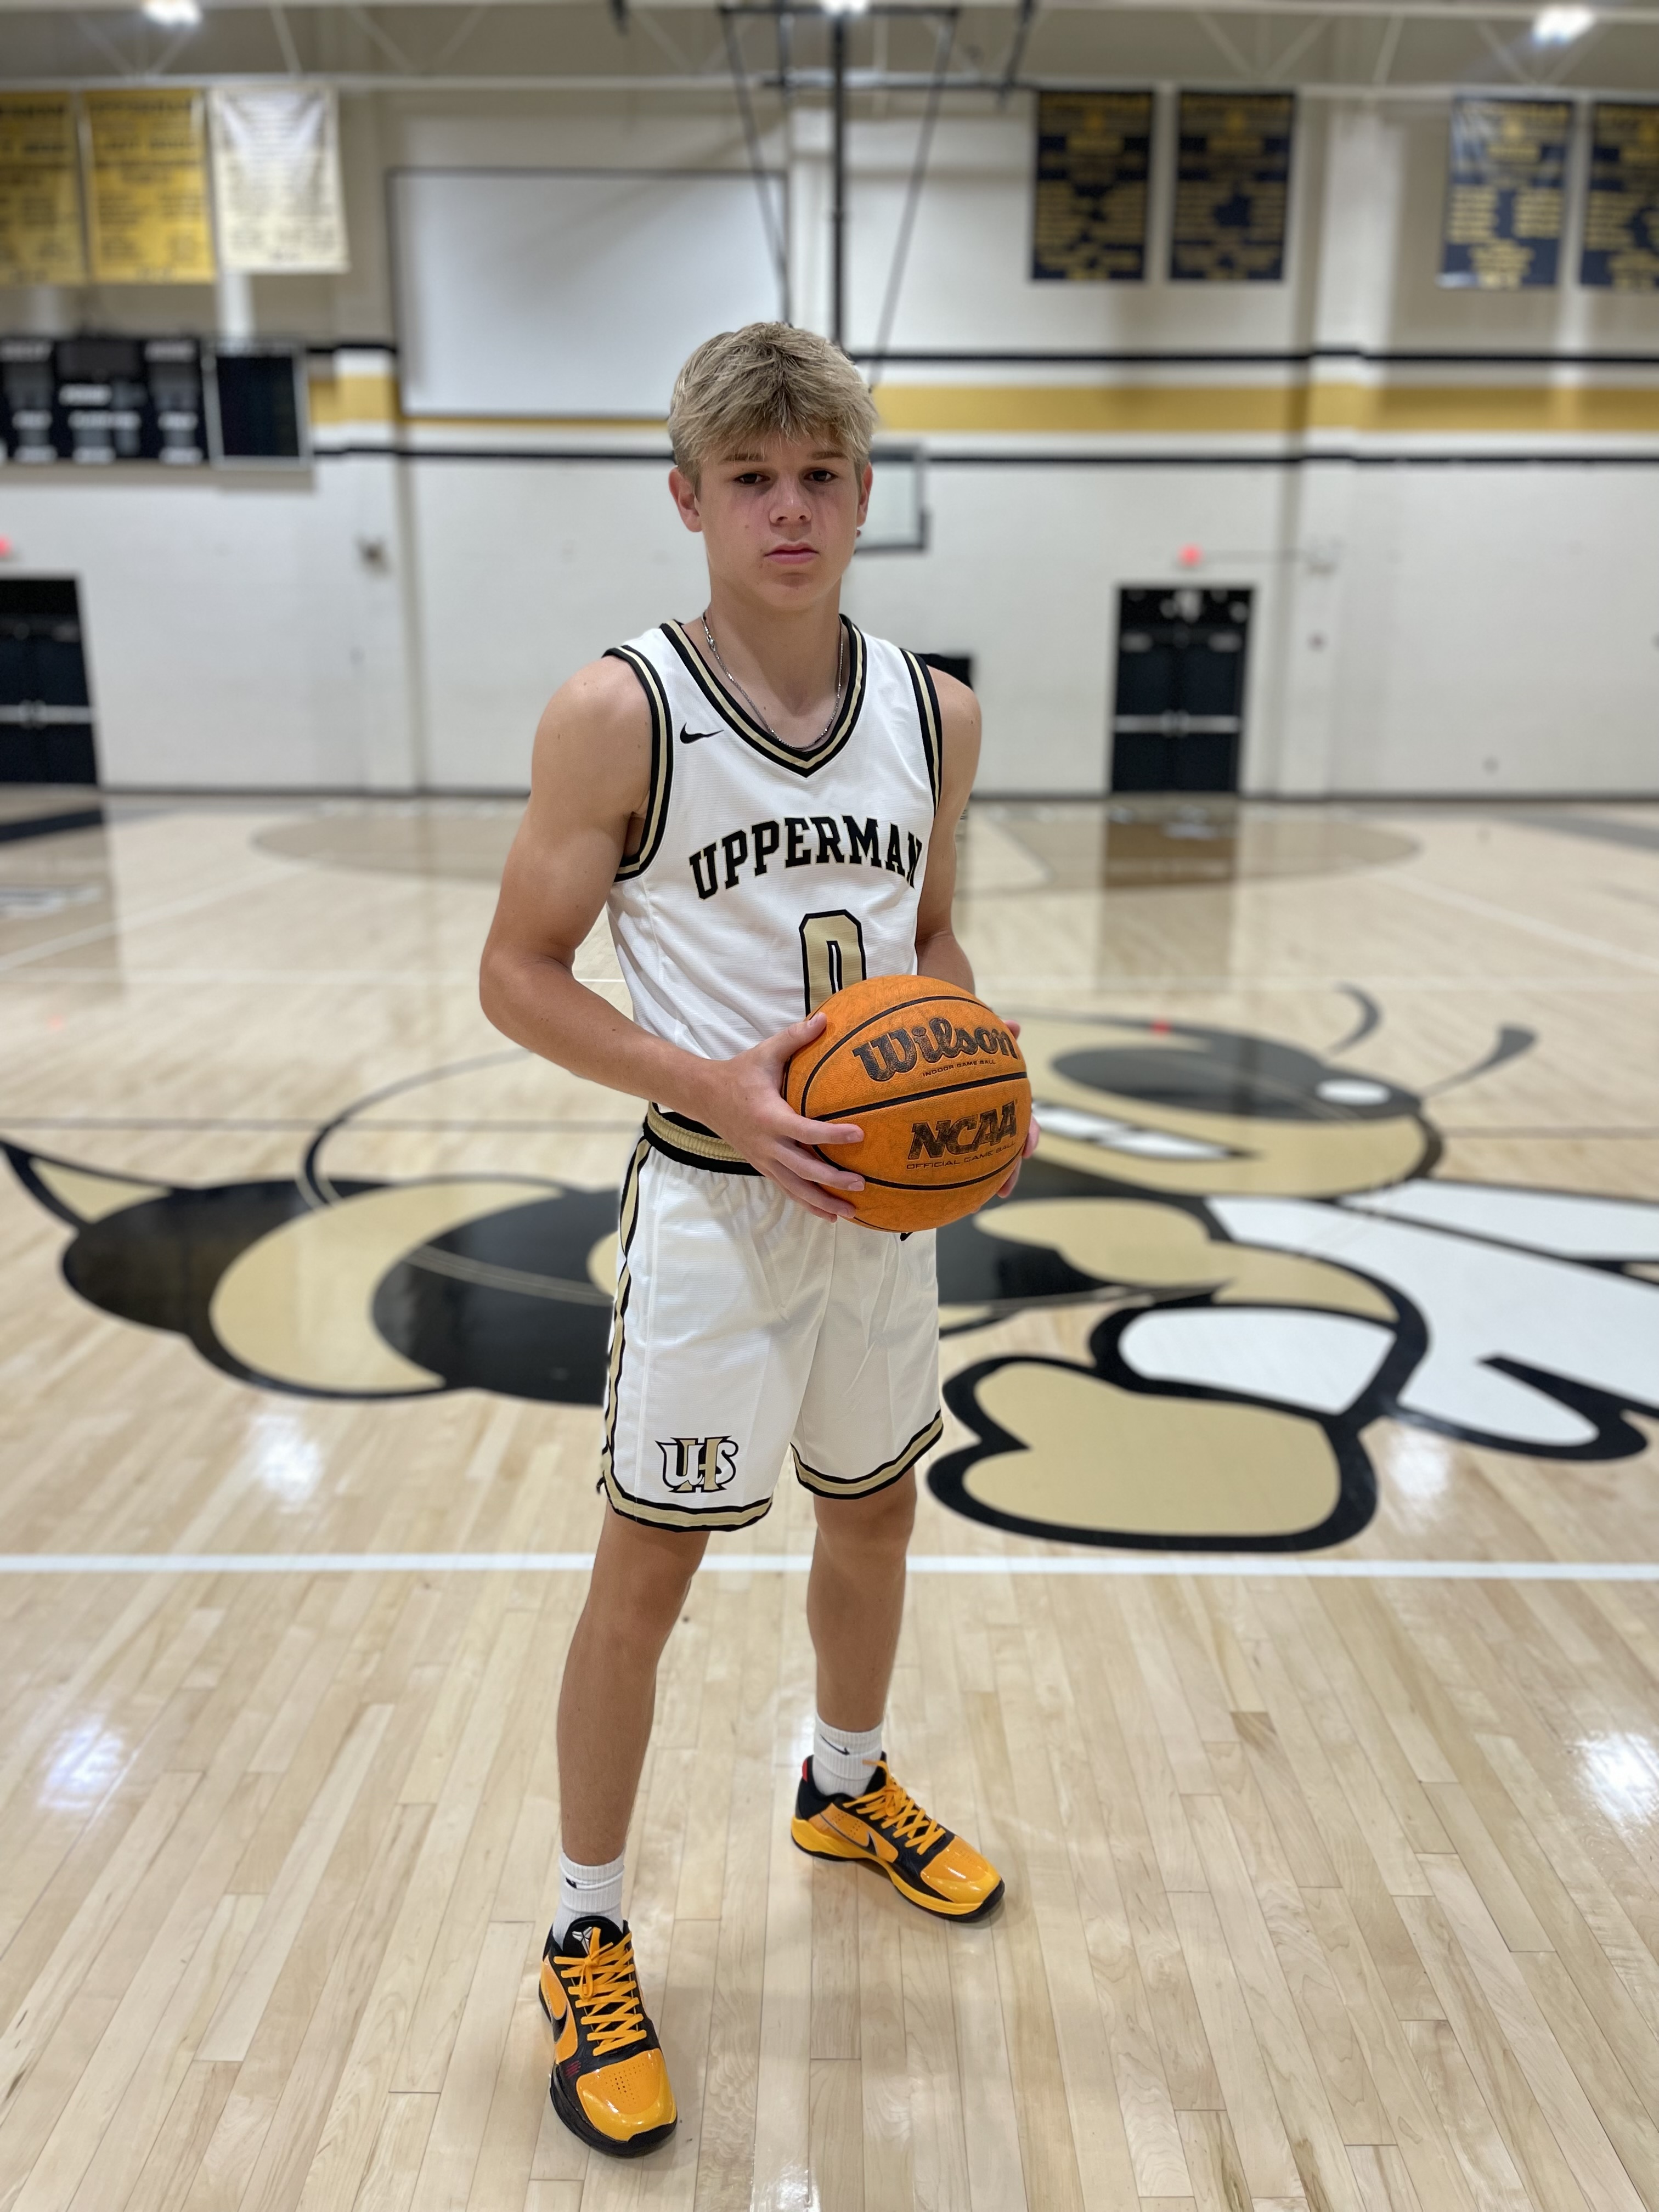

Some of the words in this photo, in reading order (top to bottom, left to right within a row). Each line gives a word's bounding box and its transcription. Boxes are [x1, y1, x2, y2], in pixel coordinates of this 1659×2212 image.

[689, 814, 923, 900] UPPERMAN
[852, 1018, 1019, 1082] Wilson
[923, 1064, 955, 1077] INDOOR
[906, 1159, 961, 1170] OFFICIAL
[963, 1149, 994, 1163] GAME
[995, 1141, 1015, 1153] BALL
[907, 1099, 1017, 1160] NCAA
